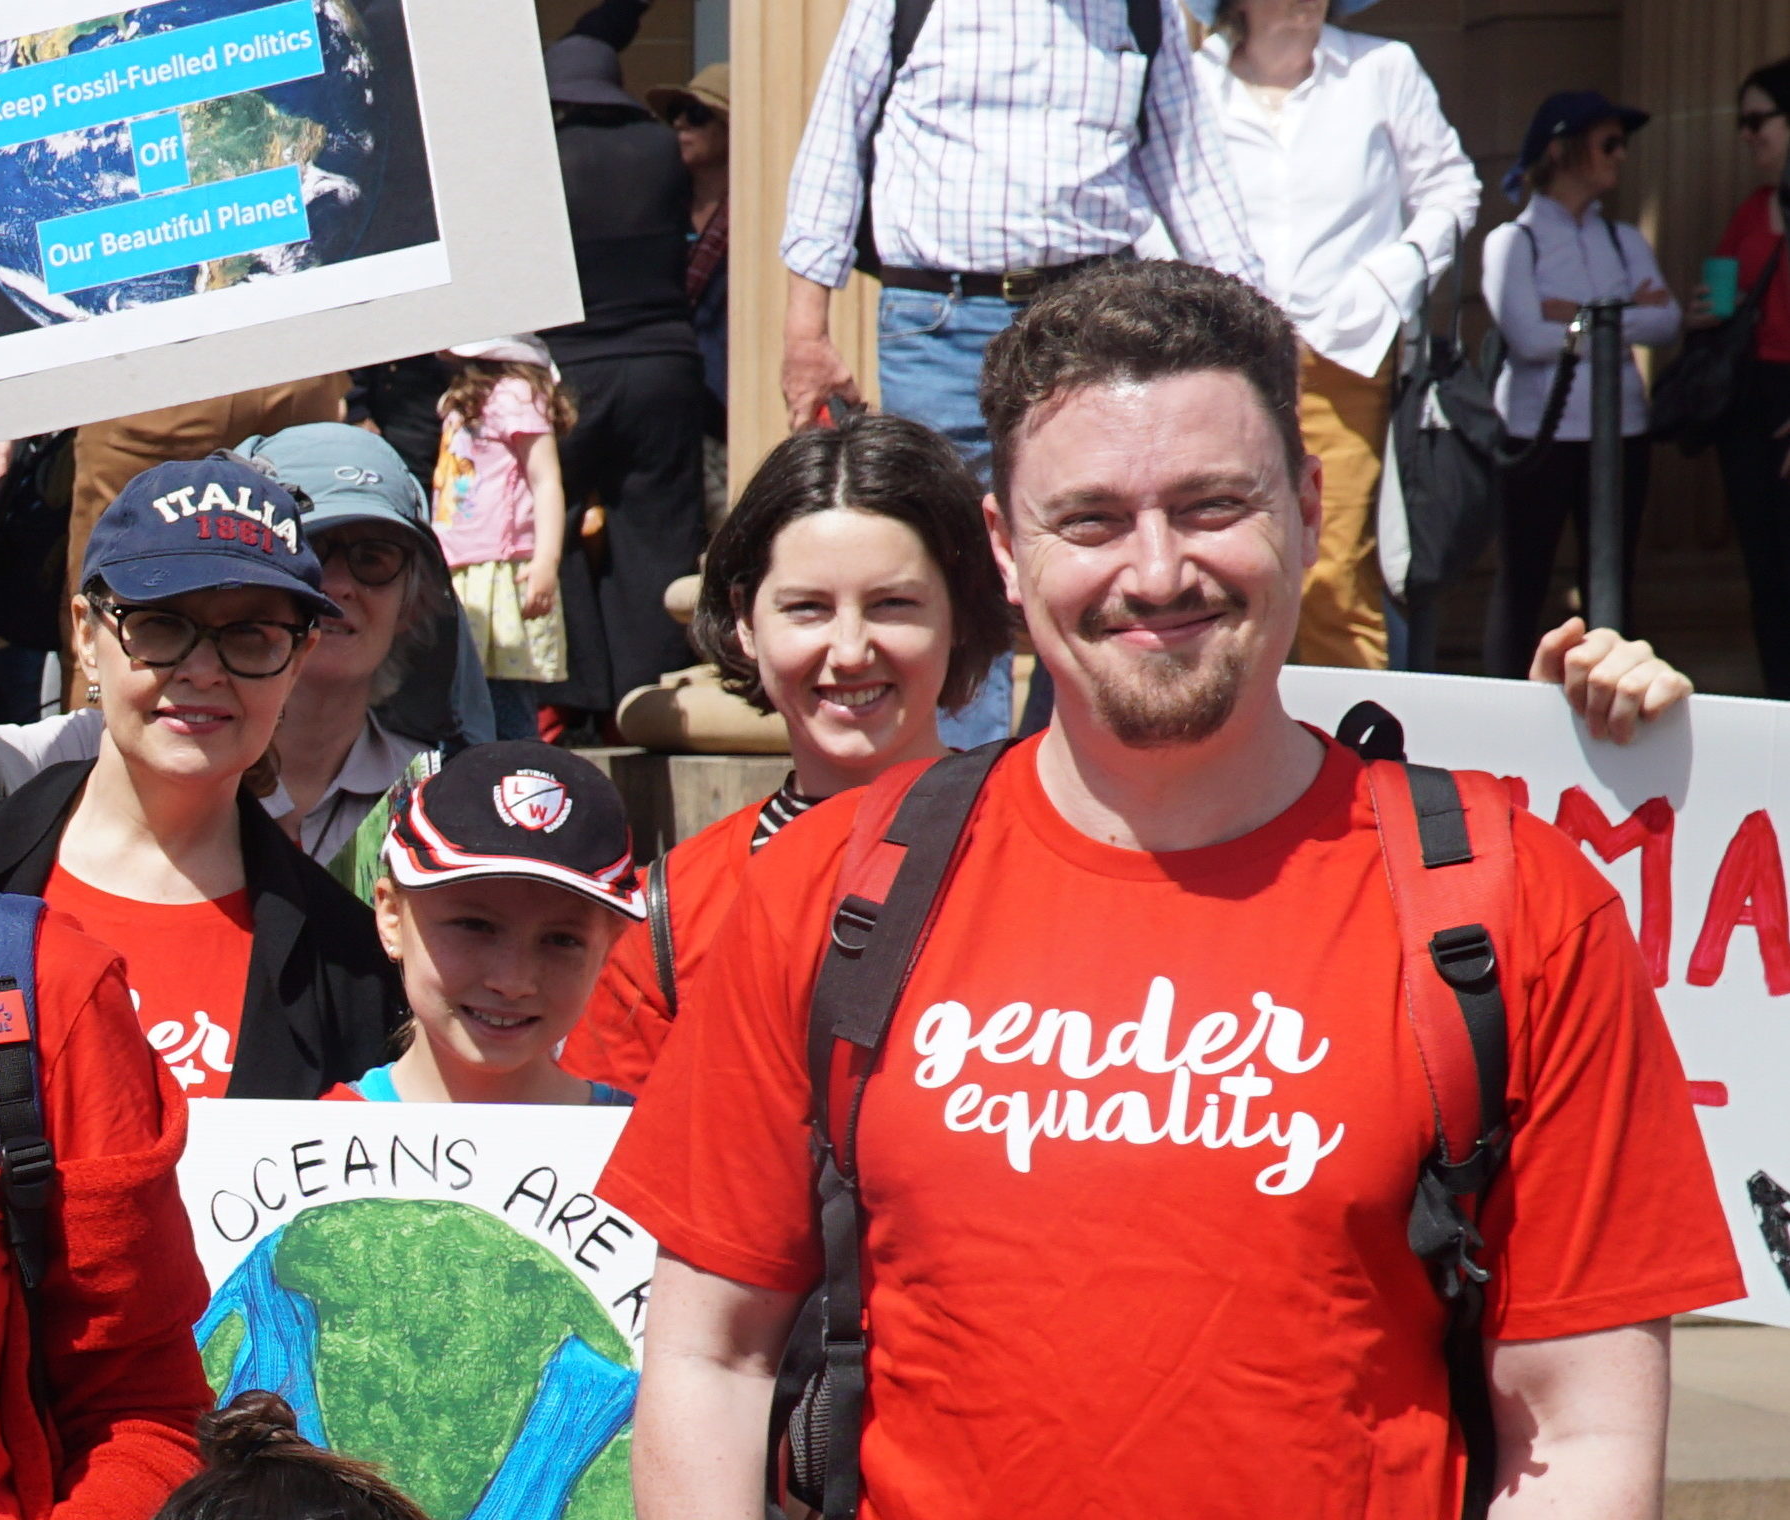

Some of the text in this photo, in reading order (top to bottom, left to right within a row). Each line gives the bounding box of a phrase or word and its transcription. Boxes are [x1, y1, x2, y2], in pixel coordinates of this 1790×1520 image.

[53, 47, 218, 107] Fossil-Fuelled
[223, 29, 313, 68] Politics
[139, 136, 179, 167] Off
[47, 192, 298, 267] Our Beautiful Planet
[153, 483, 298, 554] ITALIA
[196, 515, 275, 554] 1861
[913, 974, 1329, 1091] gender
[943, 1063, 1345, 1196] equality
[210, 1134, 635, 1275] OCEANS ARE
